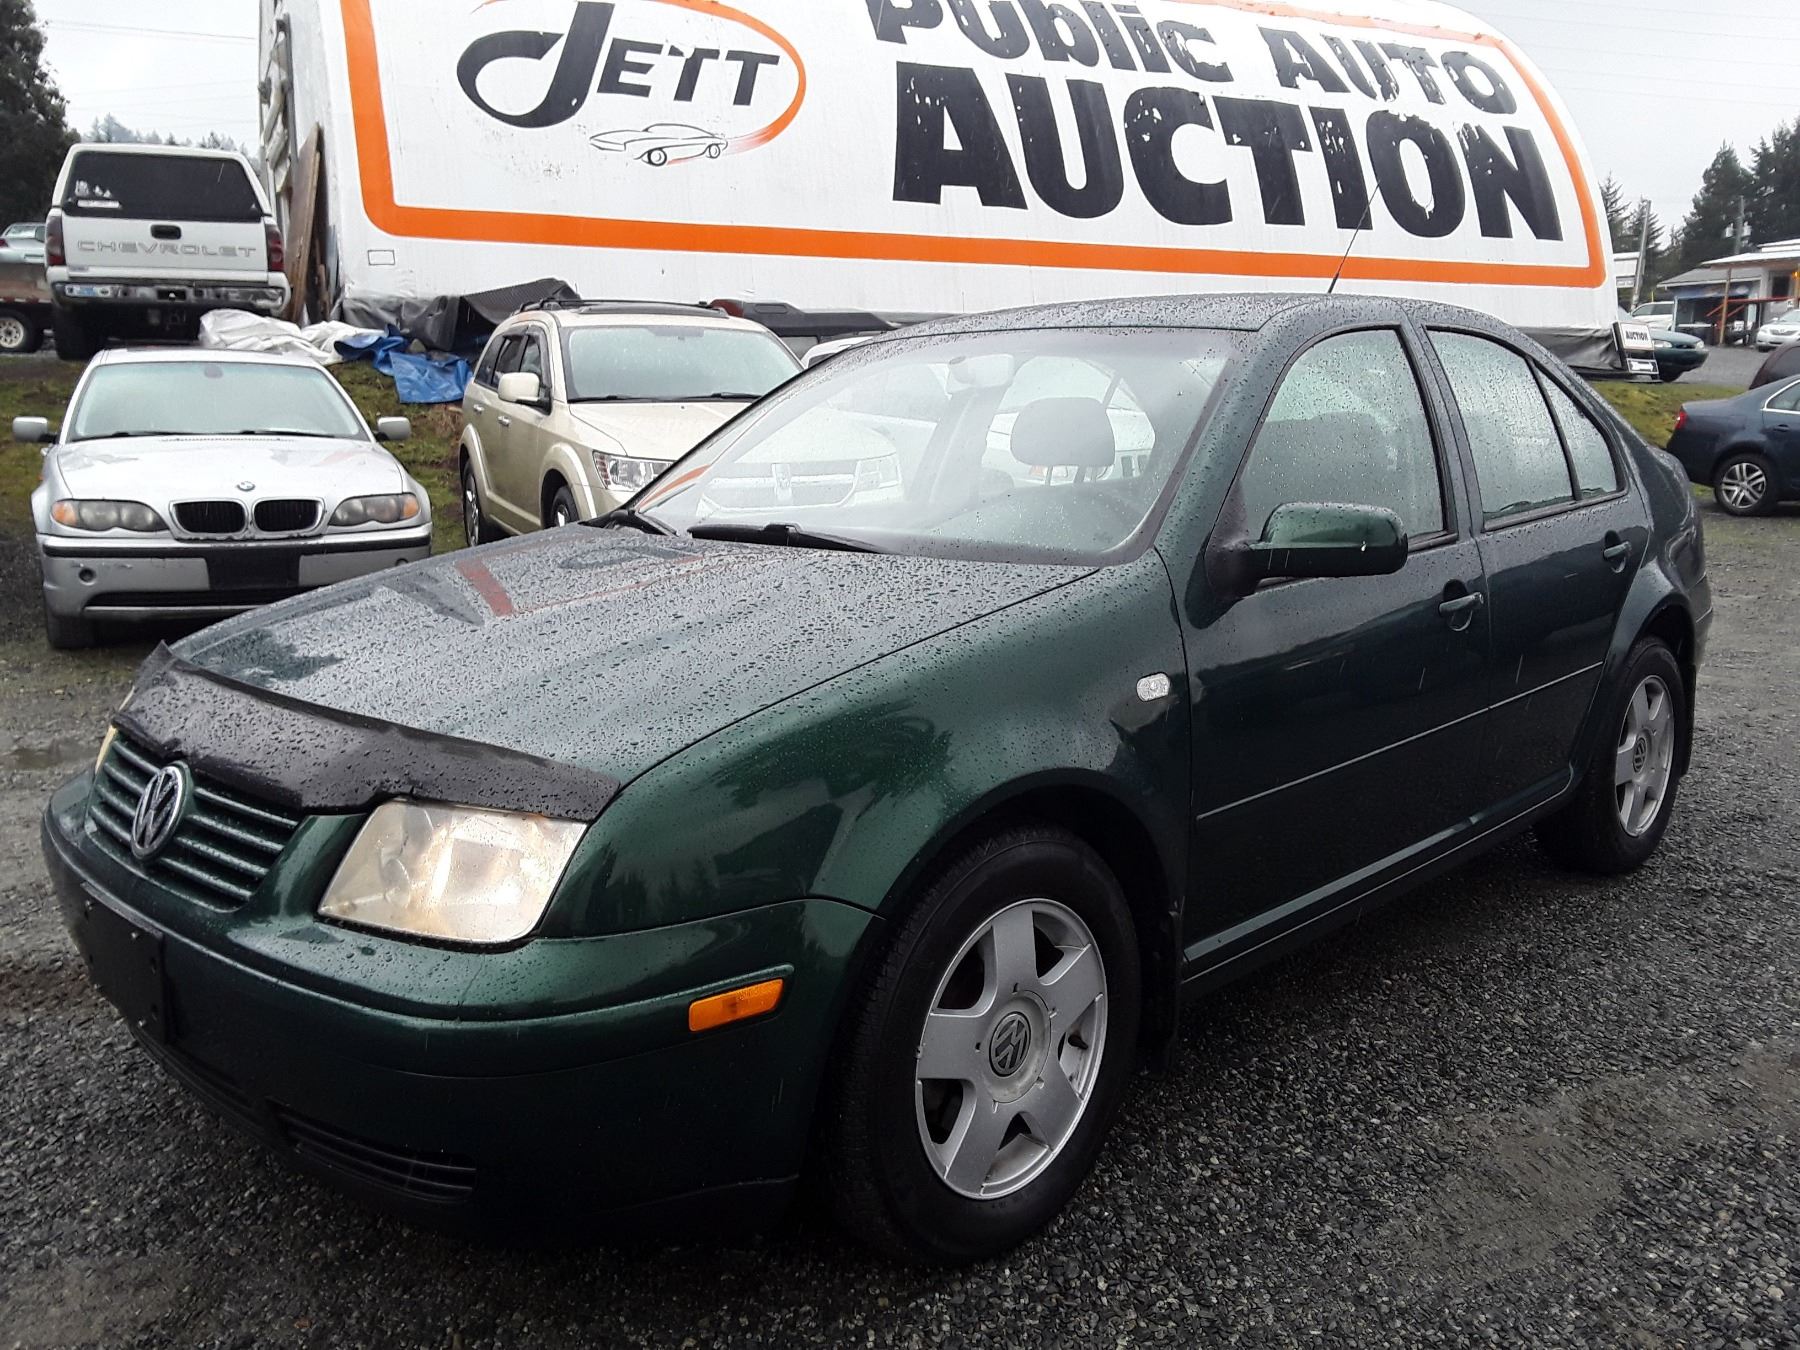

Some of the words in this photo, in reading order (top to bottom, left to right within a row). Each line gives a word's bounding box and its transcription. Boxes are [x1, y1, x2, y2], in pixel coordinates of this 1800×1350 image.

[456, 1, 780, 128] JETT
[1257, 25, 1517, 115] AUTO
[892, 60, 1563, 242] AUCTION
[77, 239, 256, 257] CHEVROLET
[1625, 330, 1649, 341] AUCTION
